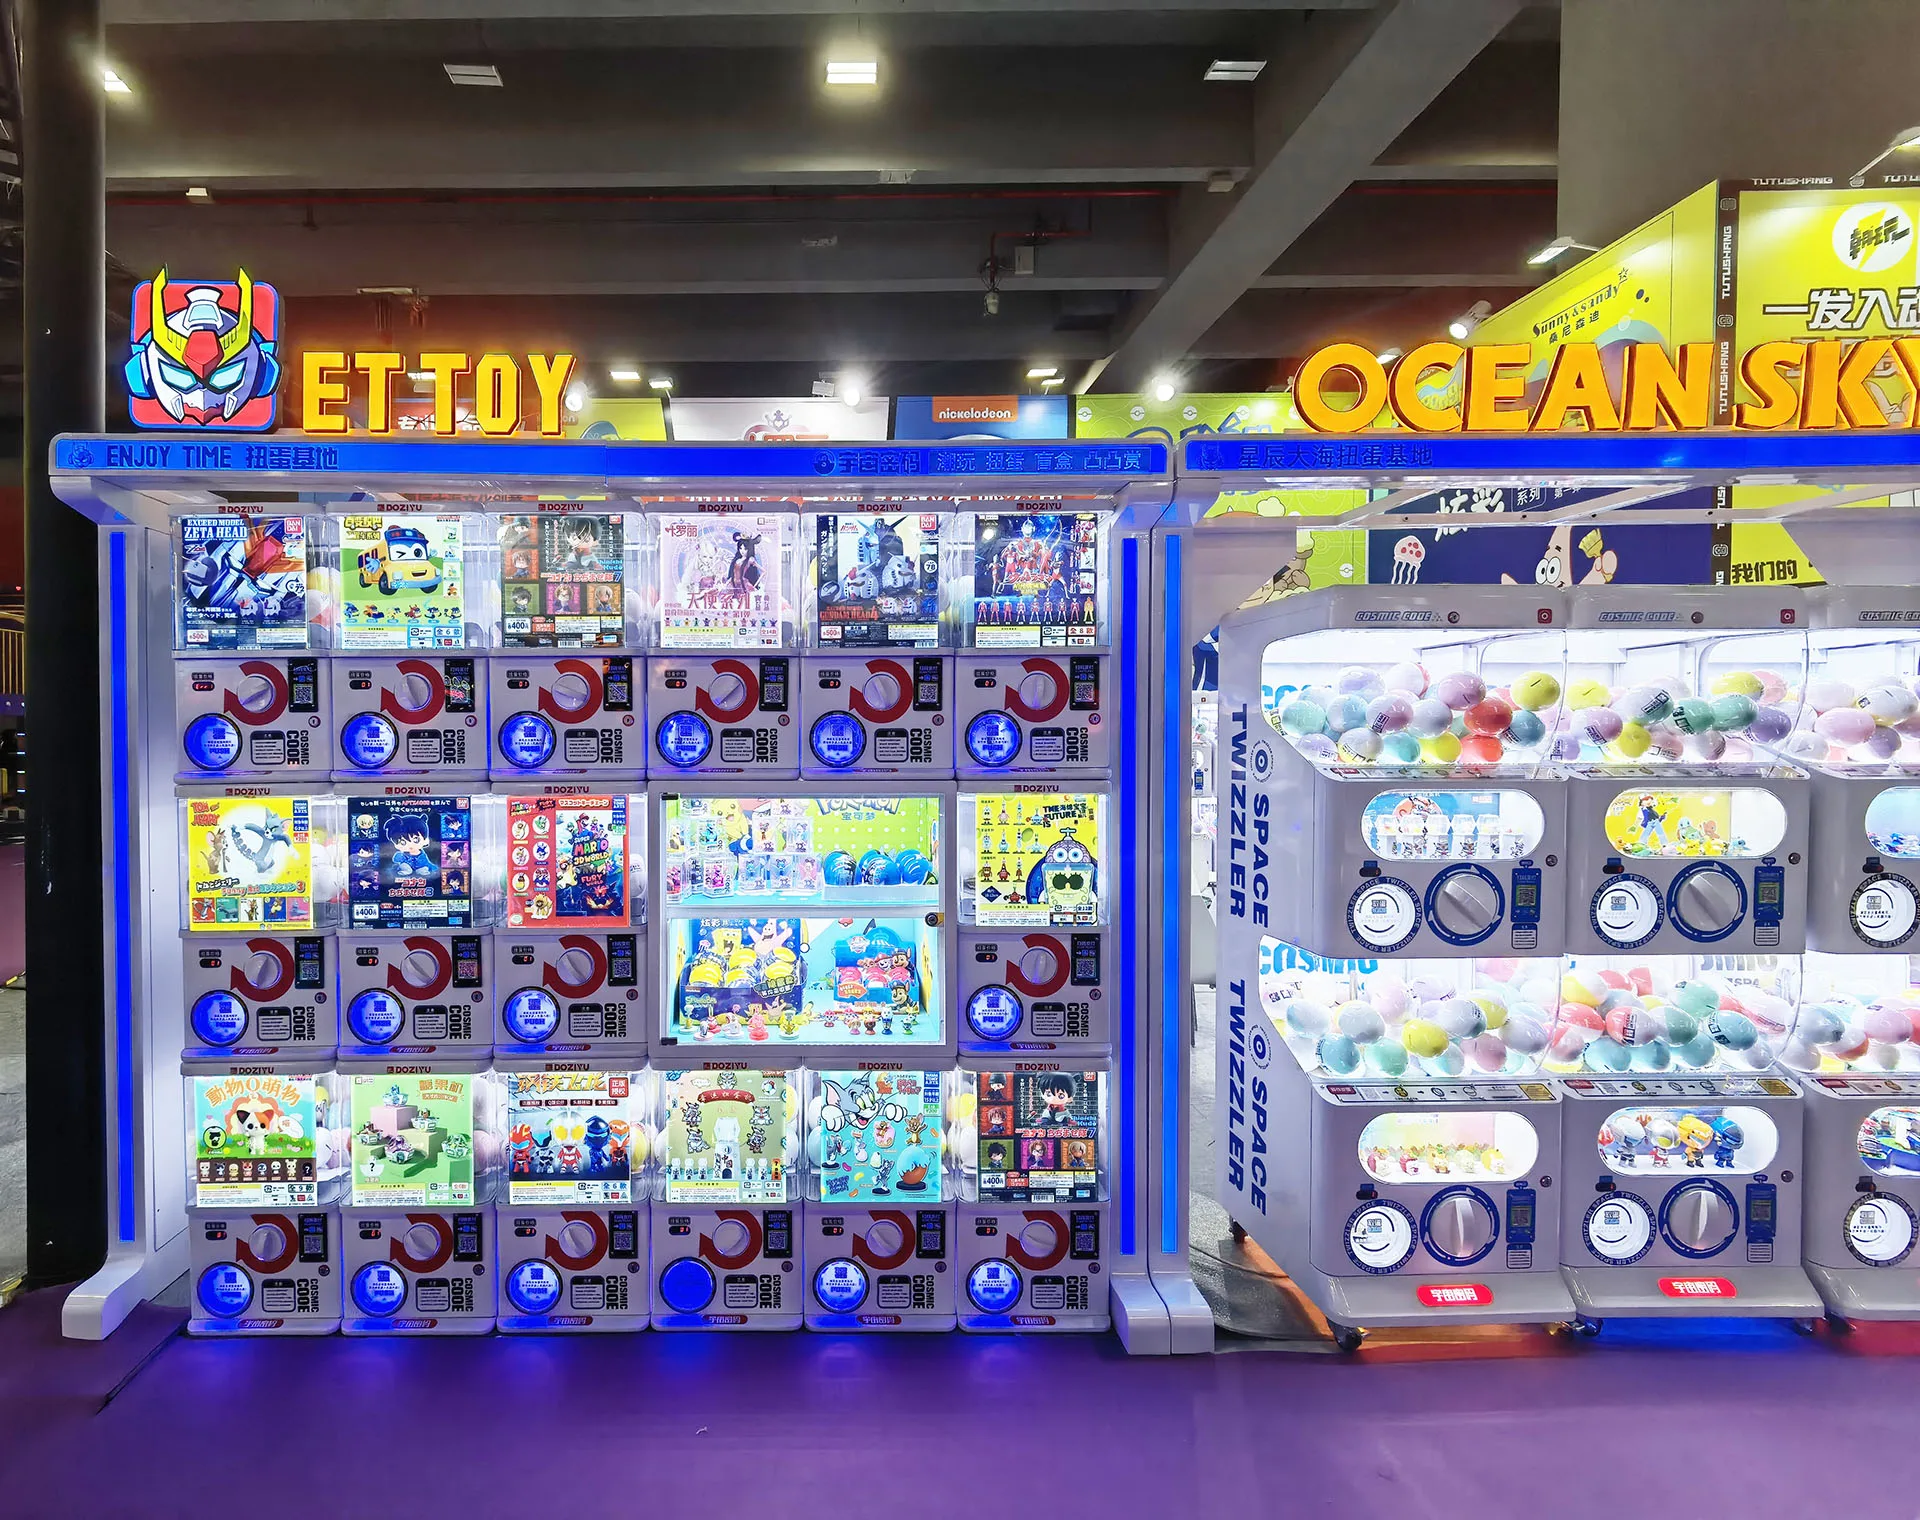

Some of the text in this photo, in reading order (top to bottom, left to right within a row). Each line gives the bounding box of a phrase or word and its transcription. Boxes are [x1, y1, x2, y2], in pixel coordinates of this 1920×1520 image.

[1752, 177, 1833, 186] TUTUSHANG
[1722, 225, 1732, 299] TUTUSHANG
[302, 351, 577, 436] ET TOY
[1292, 342, 1716, 433] OCEAN
[1720, 341, 1729, 414] TUTUSHANG
[938, 408, 1012, 420] nickelodeon
[107, 446, 338, 470] ENJOY TIME 扭蛋基地
[839, 452, 921, 474] 宇宙密码
[937, 451, 976, 471] 潮玩
[985, 451, 1025, 471] 扭蛋
[1035, 451, 1073, 471] 盲盒
[1238, 444, 1433, 469] 星辰大海扭蛋基地
[184, 527, 247, 538] ZETA HEAD
[665, 523, 698, 537] 叶罗丽
[1731, 560, 1798, 583] 我们的
[686, 591, 750, 609] 天使系列
[1355, 611, 1432, 621] COSMIC CODE
[1599, 612, 1676, 622] COSMIC CODE
[1858, 611, 1920, 621] COSMIC CO
[287, 730, 299, 765] CODE
[300, 730, 309, 765] COSMIC
[443, 729, 456, 764] CODE
[457, 729, 465, 764] COSMIC
[601, 729, 613, 764] CODE
[614, 729, 622, 763] COSMIC
[756, 728, 768, 763] CODE
[770, 728, 778, 763] COSMIC
[910, 728, 923, 763] CODE
[924, 728, 932, 763] COSMIC
[1066, 728, 1079, 762] CODE
[1080, 728, 1088, 762] COSMIC
[841, 812, 876, 821] 宝可梦
[1043, 811, 1076, 821] FUTURE
[1230, 704, 1248, 918] TWIZZLER
[574, 839, 609, 856] MARIO
[574, 852, 610, 865] 3D WORLD
[1253, 793, 1270, 928] SPACE
[581, 874, 602, 883] FURY
[1357, 878, 1380, 894] SPACE
[1386, 878, 1418, 900] TWIZZLER
[1600, 875, 1623, 892] SPACE
[1629, 875, 1662, 898] TWIZZLER
[293, 1007, 306, 1041] CODE
[306, 1007, 315, 1041] COSMIC
[449, 1005, 462, 1040] CODE
[463, 1005, 471, 1040] COSMIC
[605, 1003, 617, 1037] CODE
[618, 1003, 626, 1038] COSMIC
[1067, 1003, 1079, 1037] CODE
[1081, 1003, 1089, 1037] COSMIC
[517, 1072, 607, 1094] 钢铁飞龙
[1228, 980, 1245, 1192] TWIZZLER
[1251, 1076, 1267, 1216] SPACE
[1354, 1201, 1376, 1218] SPACE
[297, 1279, 310, 1312] CODE
[311, 1279, 319, 1313] COSMIC
[451, 1278, 464, 1312] CODE
[465, 1278, 473, 1312] COSMIC
[606, 1275, 619, 1310] CODE
[620, 1276, 628, 1310] COSMIC
[759, 1274, 772, 1309] CODE
[773, 1275, 781, 1309] COSMIC
[913, 1275, 925, 1309] CODE
[926, 1275, 935, 1309] COSMIC
[1066, 1275, 1079, 1310] CODE
[1080, 1276, 1088, 1310] COSMIC
